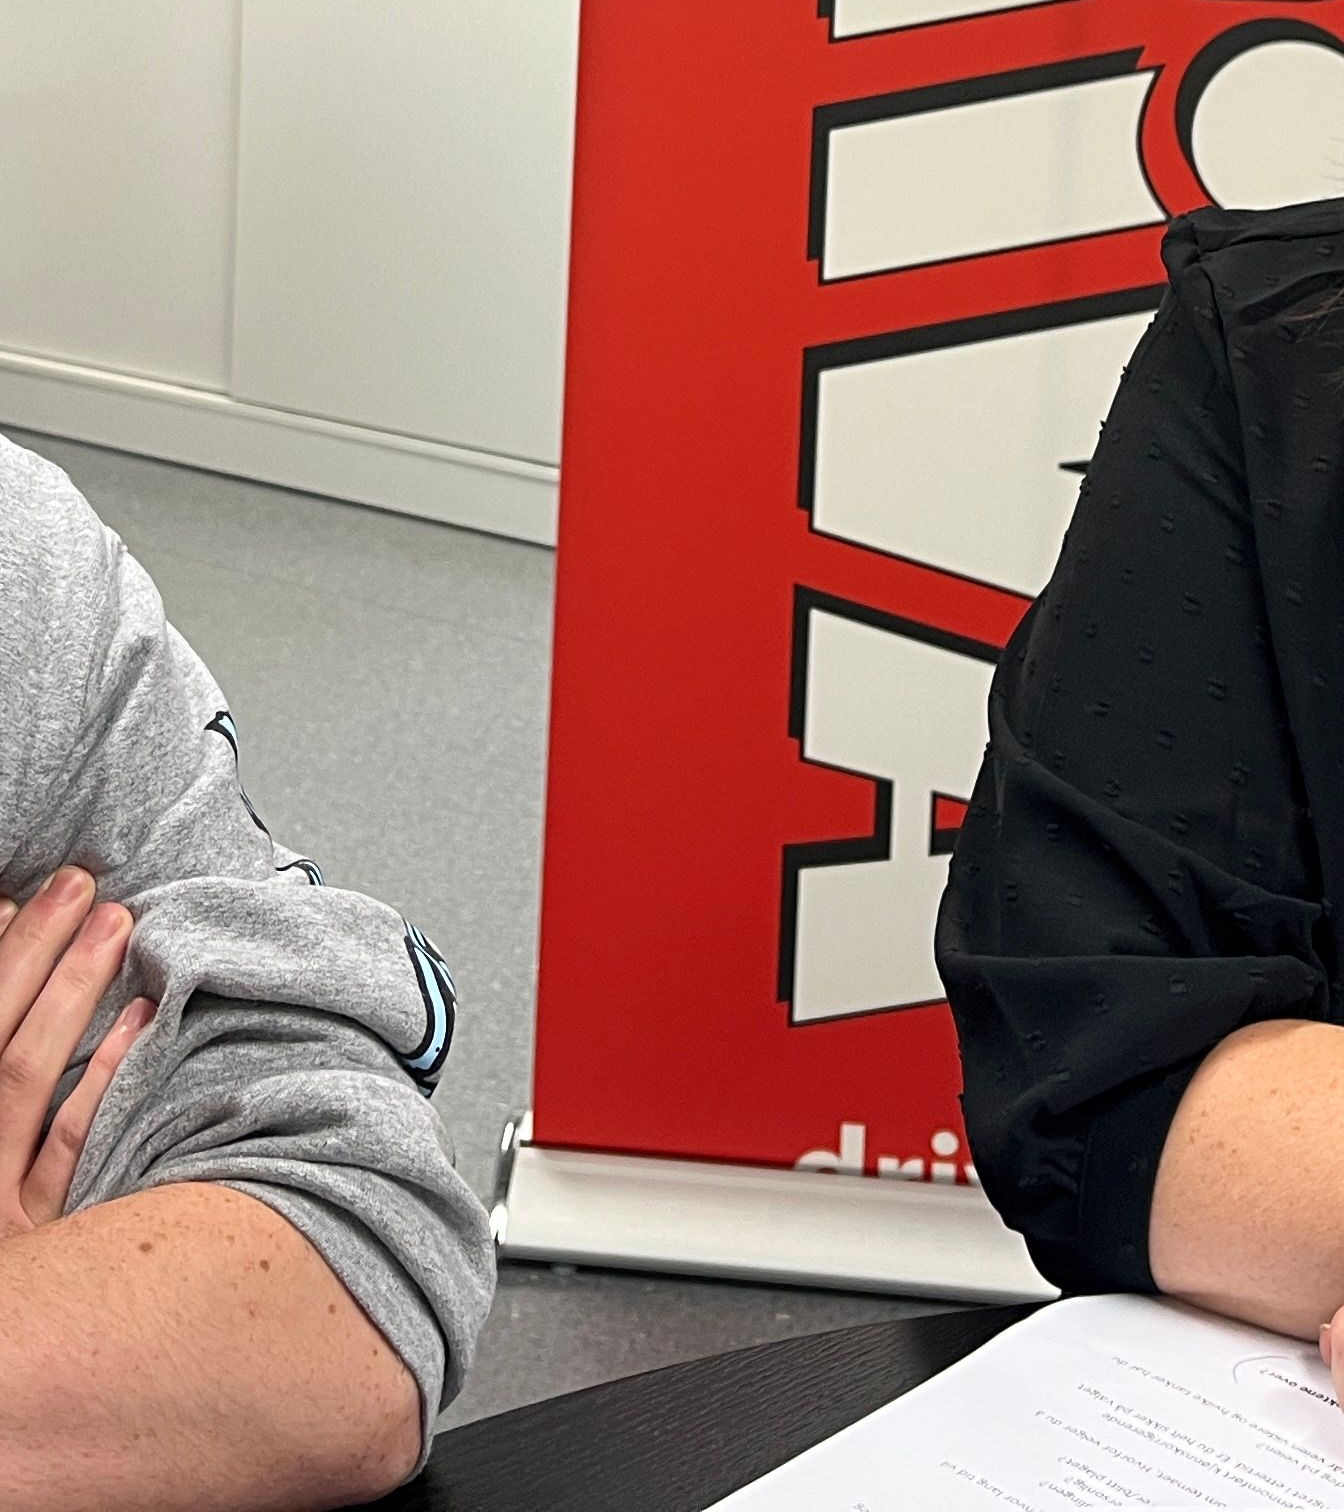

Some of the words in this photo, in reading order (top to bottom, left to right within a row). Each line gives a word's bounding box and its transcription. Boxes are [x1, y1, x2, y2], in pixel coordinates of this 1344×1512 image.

[1111, 1356, 1127, 1367] du
[1129, 1365, 1150, 1378] har
[1151, 1375, 1191, 1396] tanker
[1077, 1384, 1113, 1407] valget
[1300, 1386, 1340, 1408] ktene
[1115, 1404, 1133, 1415] på
[1230, 1412, 1247, 1425] og
[1046, 1415, 1062, 1425] du
[1133, 1413, 1170, 1433] sikker
[1064, 1425, 1100, 1446] velger
[1101, 1412, 1222, 1475] kjønnskorrigerende
[1170, 1429, 1195, 1446] helt
[1248, 1423, 1288, 1446] videre
[1196, 1443, 1214, 1454] du
[1216, 1453, 1231, 1463] Er
[1255, 1442, 1299, 1465] veien?
[1101, 1445, 1152, 1473] Hvorfor
[1058, 1456, 1106, 1482] plaget?
[1300, 1464, 1320, 1476] på
[977, 1478, 1003, 1497] lang
[1223, 1471, 1304, 1510] ennomført
[1318, 1473, 1344, 1490] deg
